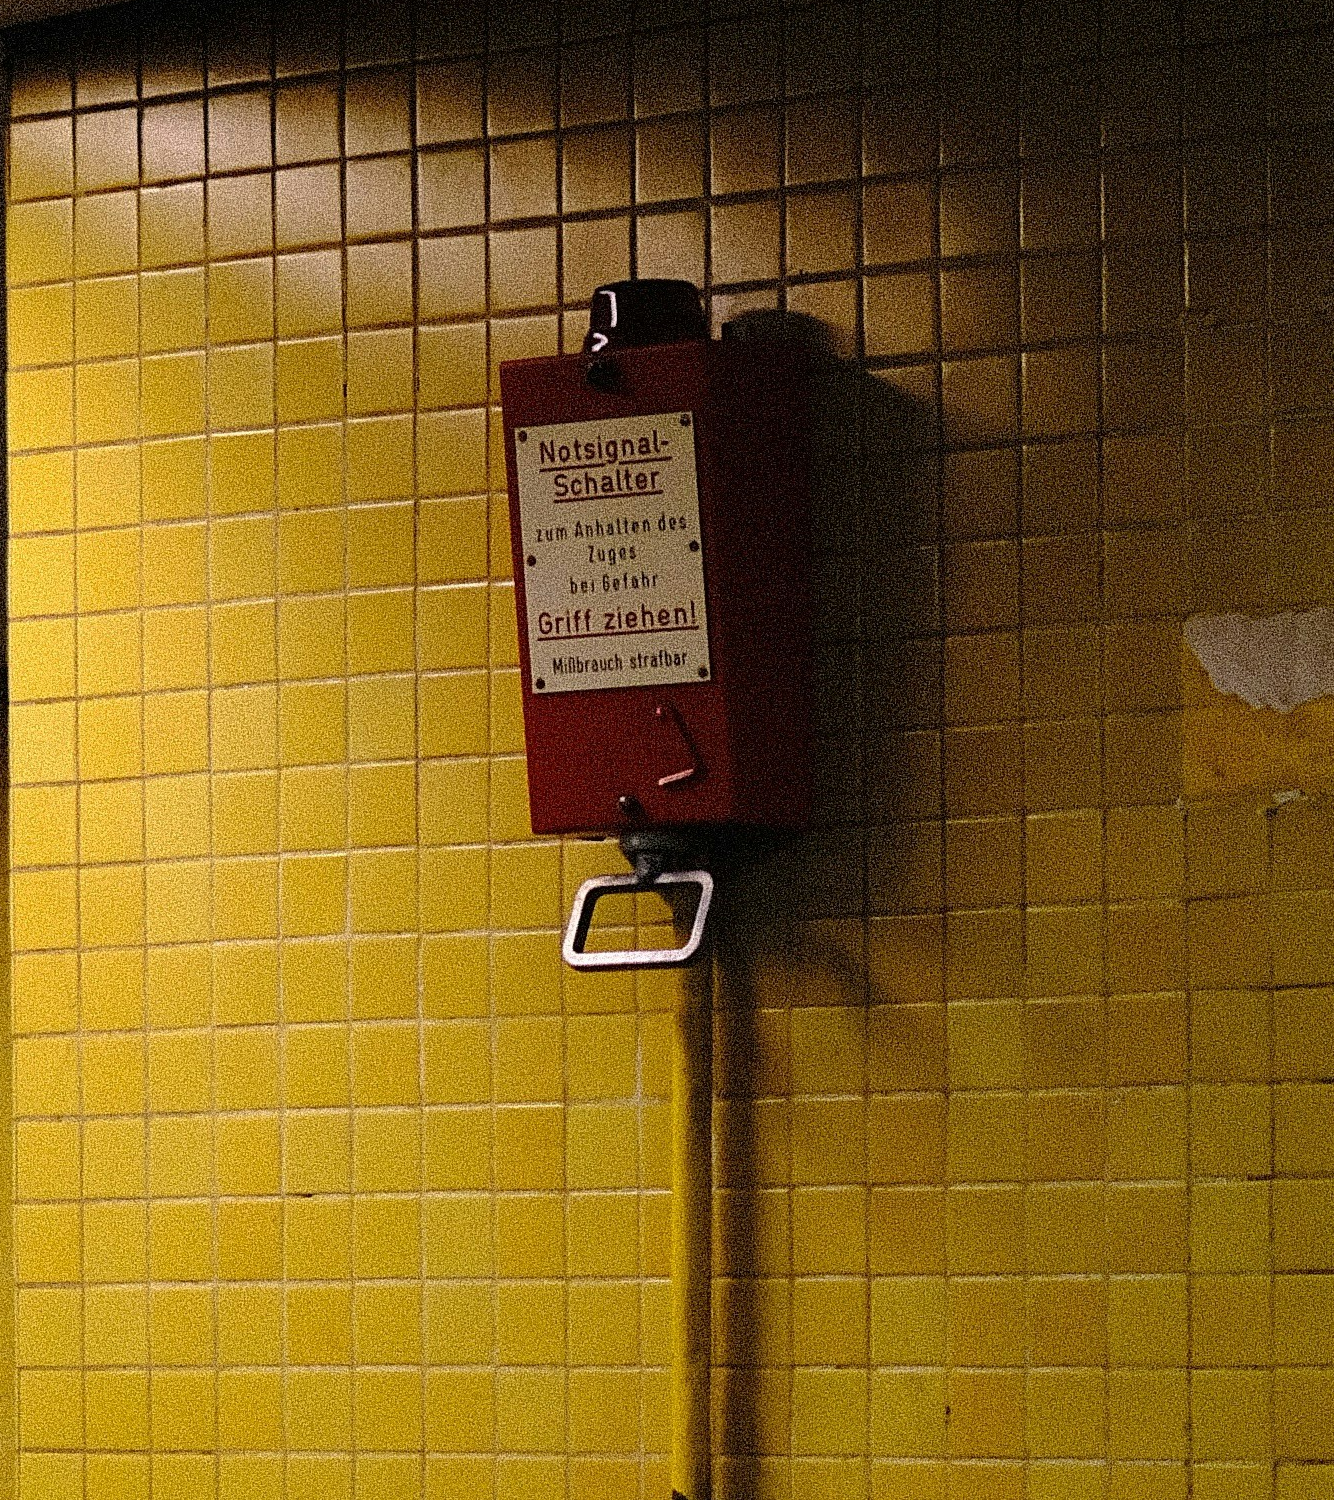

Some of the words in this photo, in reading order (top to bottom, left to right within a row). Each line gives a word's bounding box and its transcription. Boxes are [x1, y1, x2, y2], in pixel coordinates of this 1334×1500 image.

[539, 430, 669, 465] Notsignal-
[554, 468, 660, 497] Schalter
[536, 526, 567, 542] zum
[574, 517, 651, 538] Anhalten
[658, 514, 687, 531] des
[588, 544, 637, 565] Zuges
[570, 576, 595, 594] bei
[602, 572, 658, 592] Gefahr
[538, 609, 592, 635] Griff
[604, 600, 696, 631] ziehen!
[552, 653, 623, 675] Mißbrauch
[629, 649, 688, 670] strafbar
